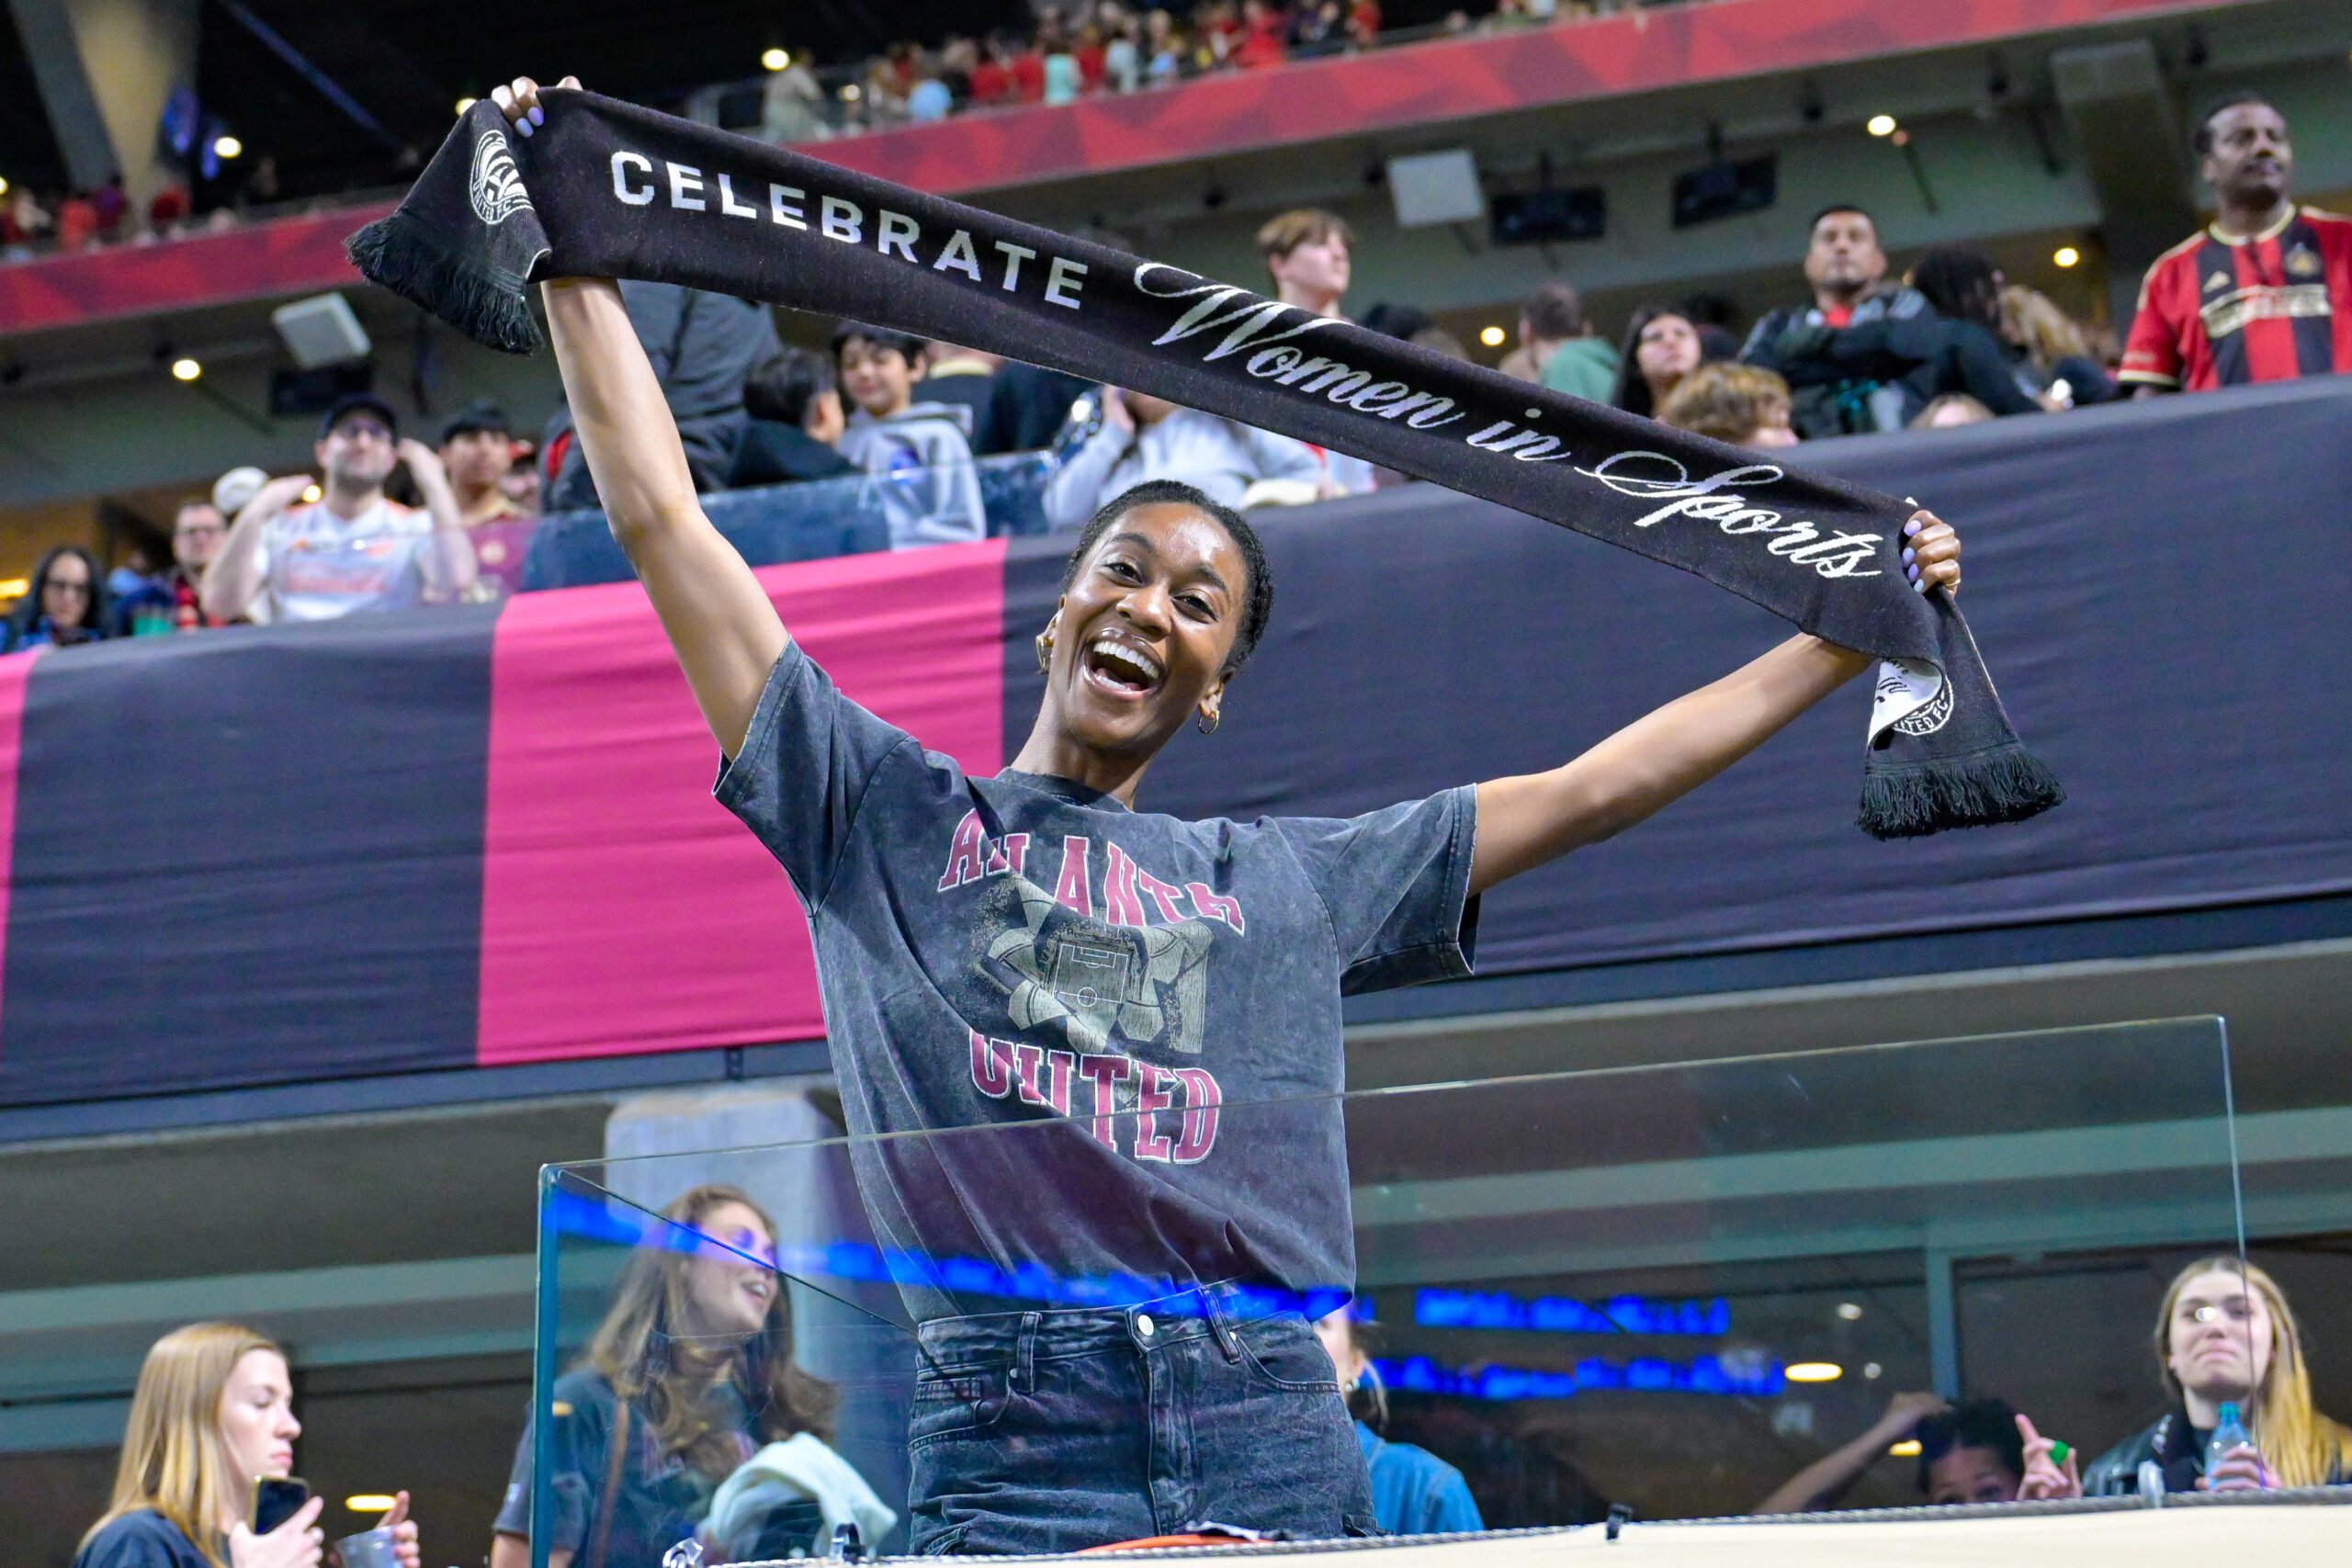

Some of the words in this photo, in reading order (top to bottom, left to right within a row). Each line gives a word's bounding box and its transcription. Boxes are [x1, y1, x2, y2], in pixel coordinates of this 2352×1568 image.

[496, 199, 513, 220] FC
[610, 150, 1089, 310] CELEBRATE
[1133, 262, 1466, 430] Women
[1465, 407, 1572, 462] in
[1573, 449, 1883, 579] Sports
[1894, 716, 1935, 732] ITED
[1932, 699, 1950, 721] FC
